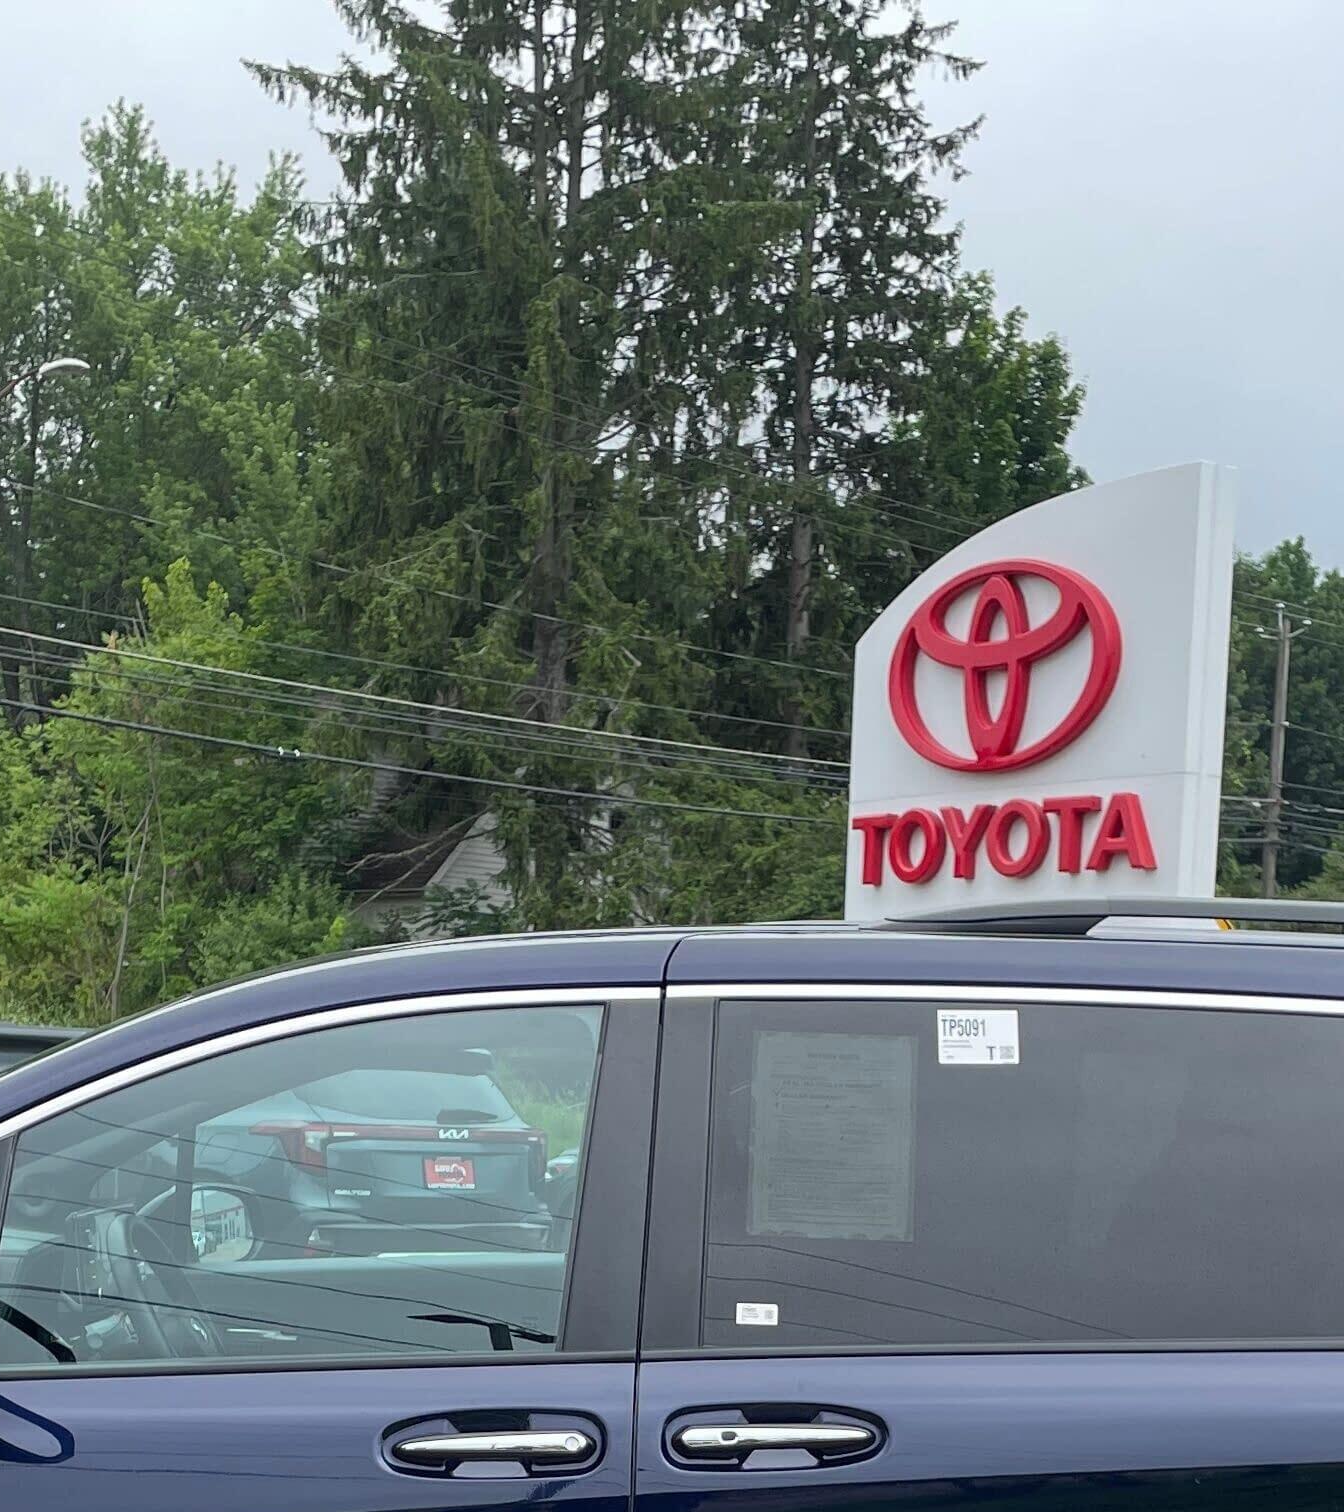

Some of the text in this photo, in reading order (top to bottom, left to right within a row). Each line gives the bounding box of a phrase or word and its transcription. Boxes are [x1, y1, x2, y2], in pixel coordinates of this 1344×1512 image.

[852, 792, 1157, 886] TOYOTA
[941, 1018, 986, 1037] TP5091
[986, 1046, 996, 1060] T
